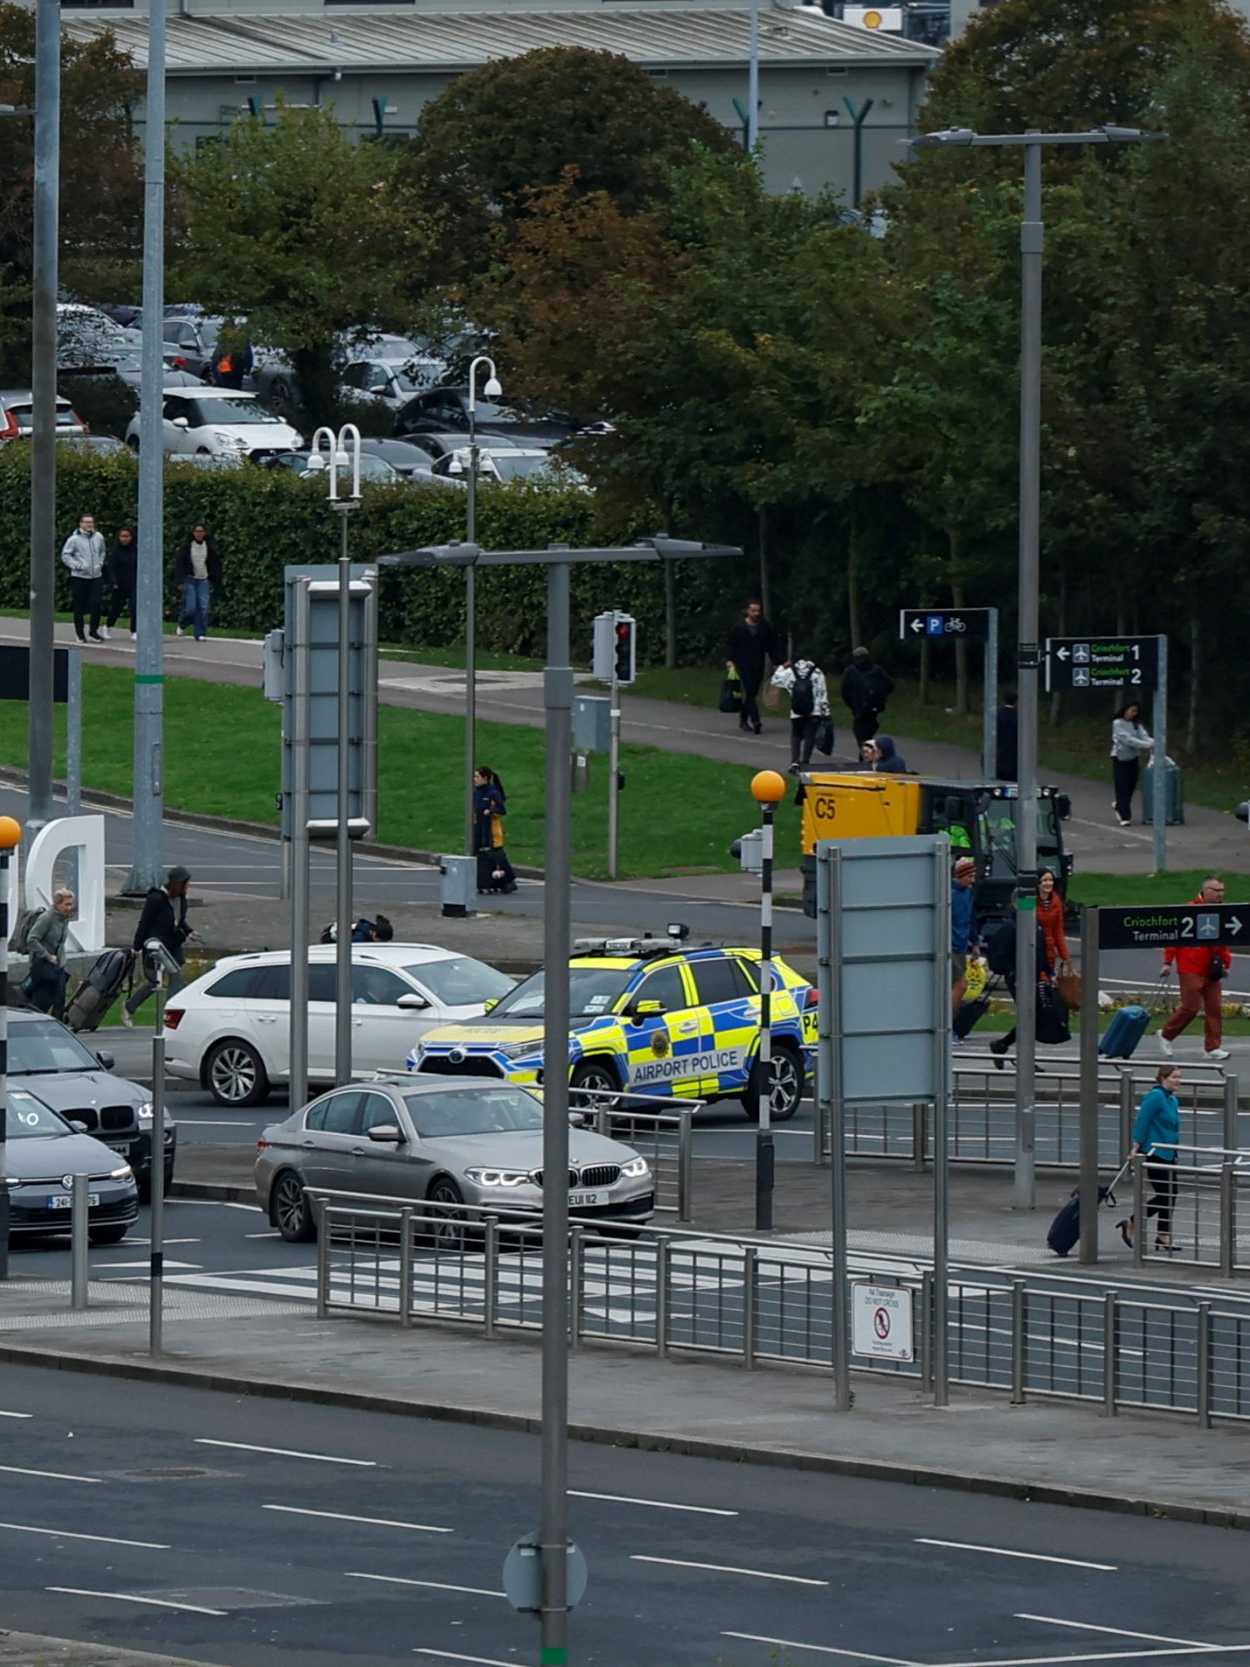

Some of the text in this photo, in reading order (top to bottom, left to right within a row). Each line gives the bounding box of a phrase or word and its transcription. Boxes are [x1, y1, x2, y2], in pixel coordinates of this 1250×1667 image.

[931, 620, 939, 631] P
[1091, 654, 1124, 662] Terminal
[1131, 645, 1139, 660] 1
[1091, 677, 1124, 686] Terminal
[1131, 668, 1142, 684] 2
[815, 797, 836, 820] C5
[1181, 917, 1194, 938] 2
[1133, 930, 1179, 941] Terminal
[634, 1051, 738, 1082] AIRPORT POLICE
